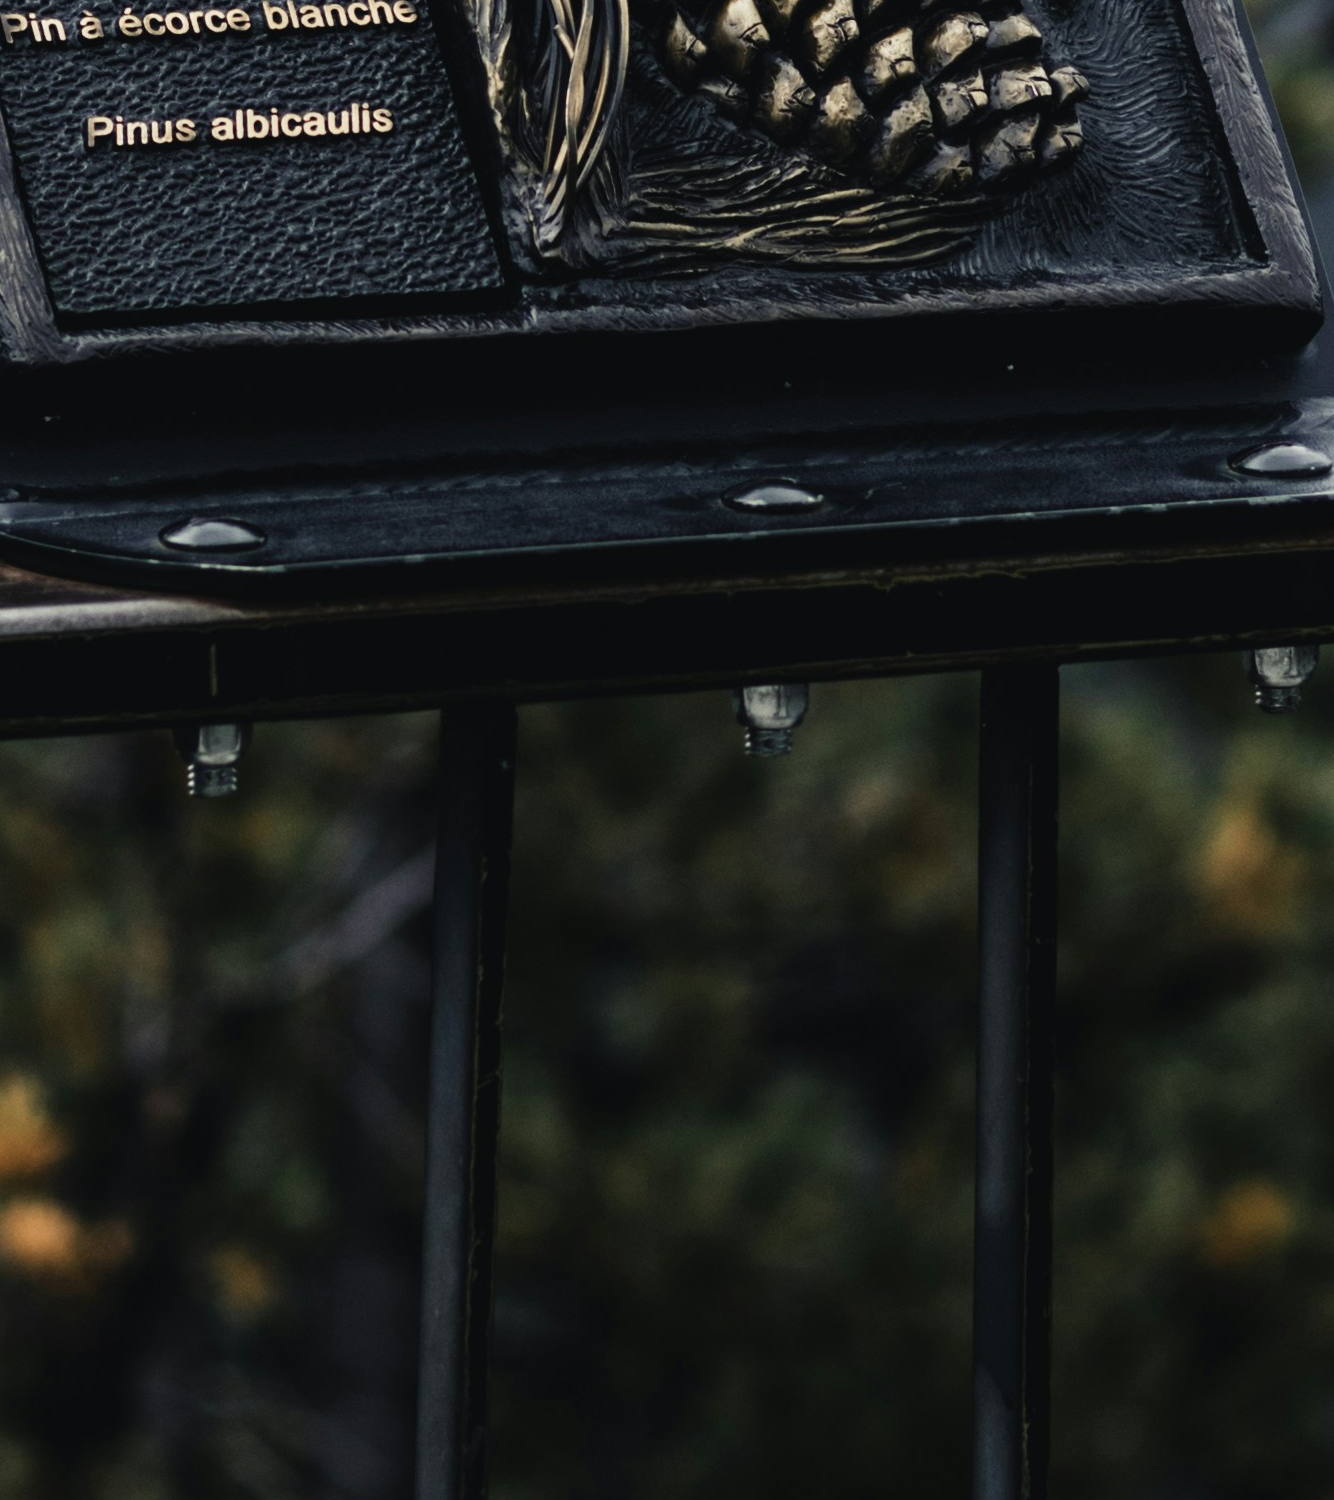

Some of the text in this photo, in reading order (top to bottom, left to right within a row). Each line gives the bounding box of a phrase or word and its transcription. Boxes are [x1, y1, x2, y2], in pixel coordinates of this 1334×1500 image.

[0, 12, 67, 44] Pin
[79, 10, 104, 40] à
[118, 6, 251, 37] écorce
[86, 102, 394, 148] Pinus albicaulis
